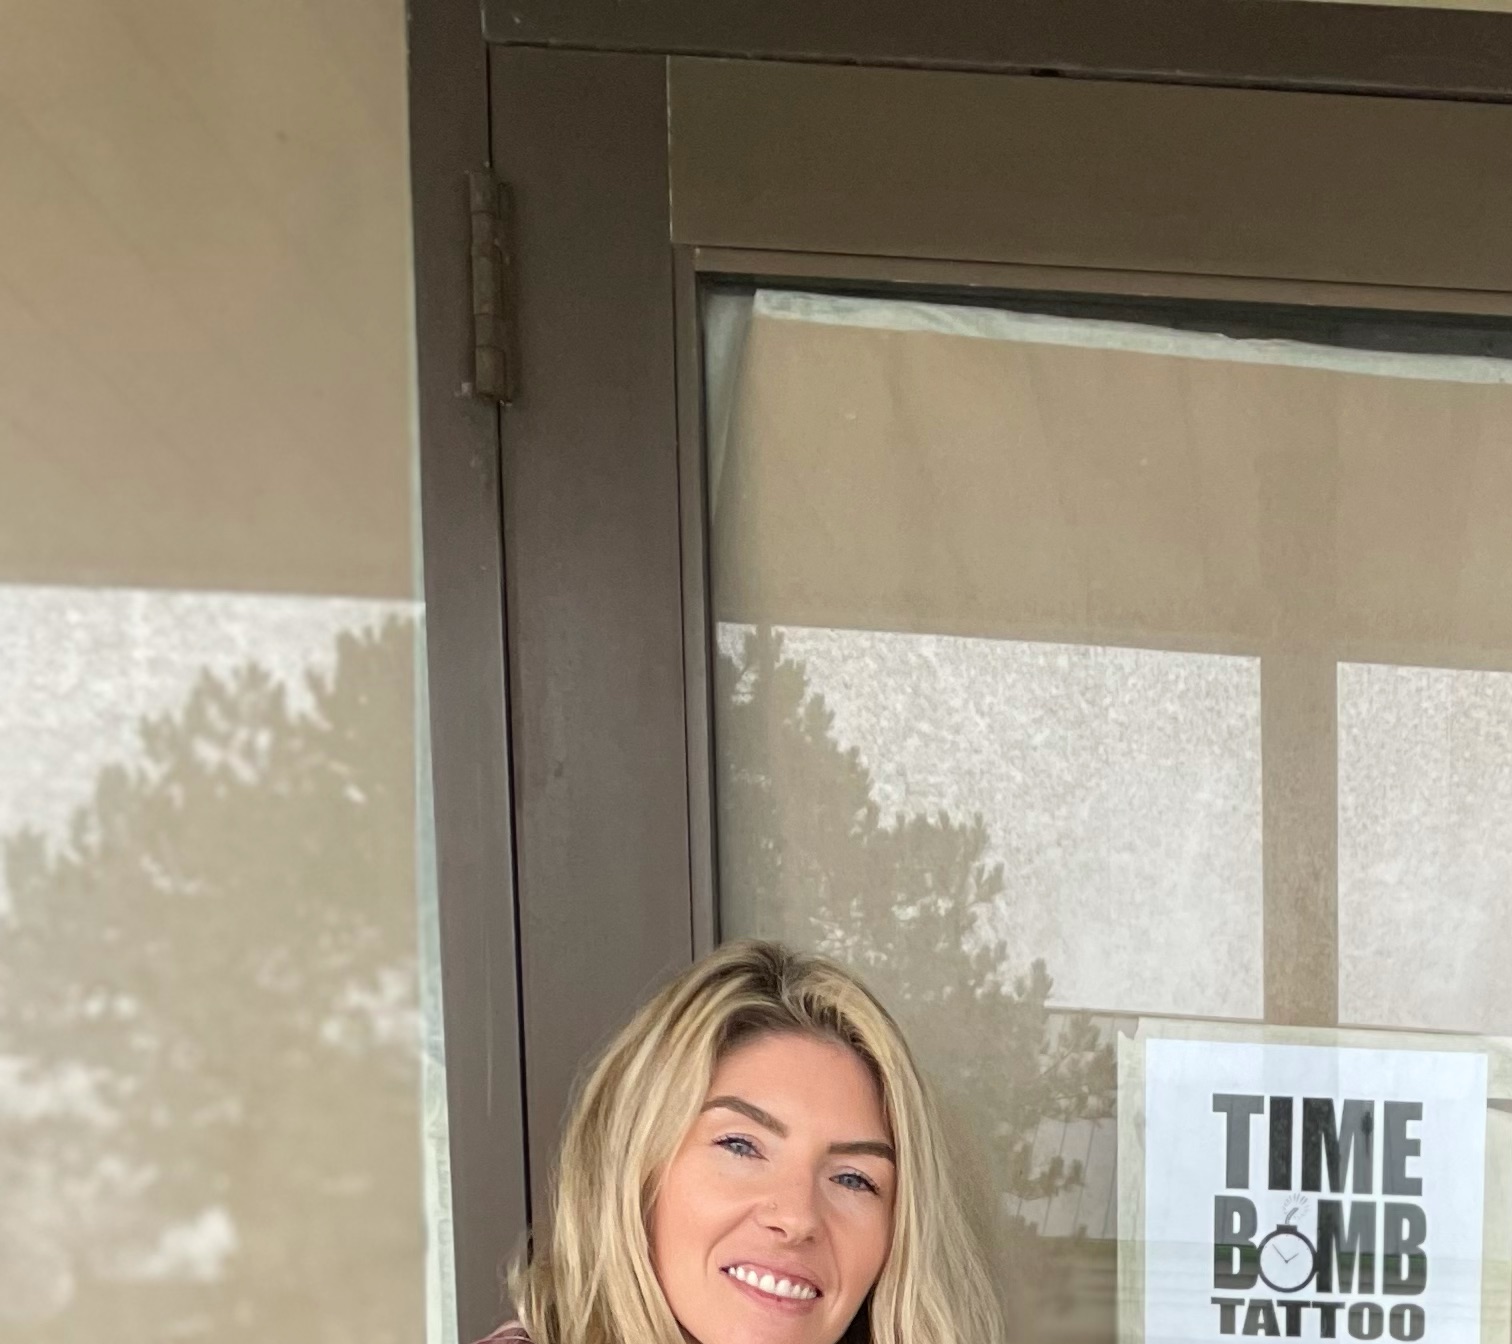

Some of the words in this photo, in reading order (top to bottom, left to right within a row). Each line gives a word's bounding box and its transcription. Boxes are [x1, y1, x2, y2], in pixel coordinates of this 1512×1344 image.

[1212, 1093, 1423, 1196] TIME
[1213, 1194, 1427, 1296] BOMB
[1211, 1297, 1426, 1342] TATTOO
